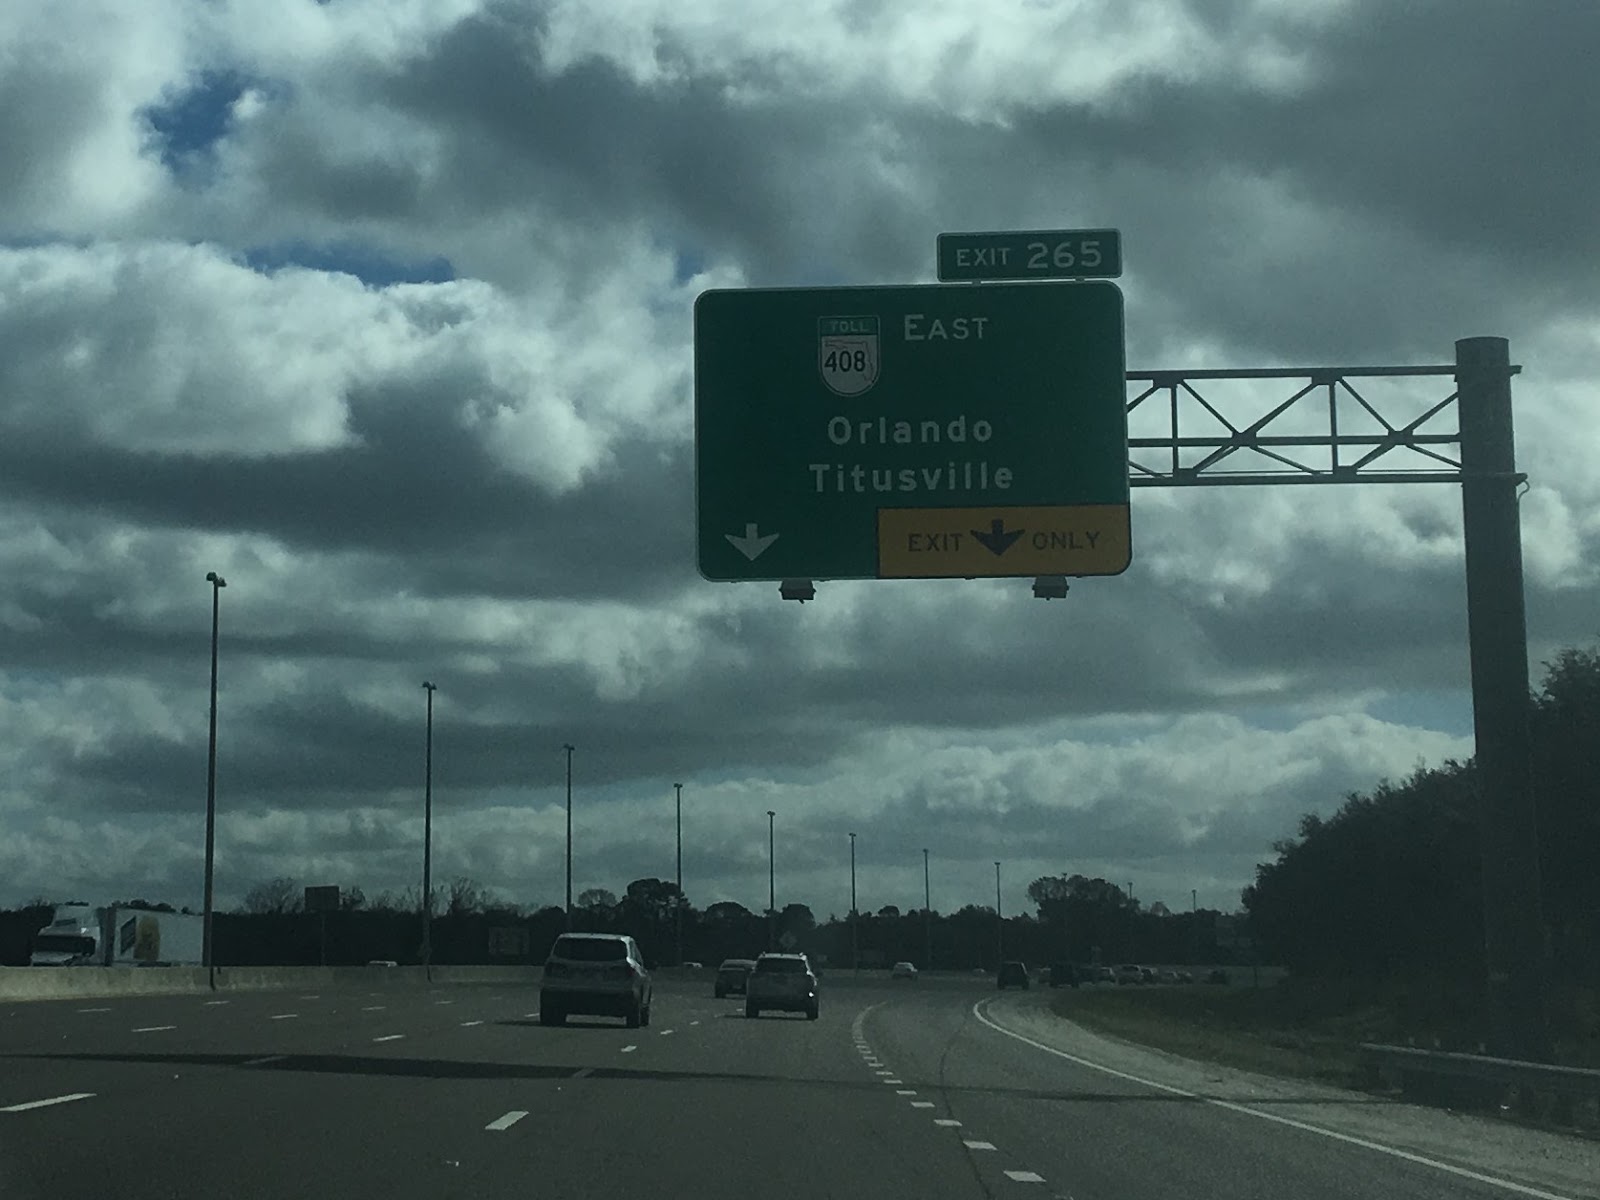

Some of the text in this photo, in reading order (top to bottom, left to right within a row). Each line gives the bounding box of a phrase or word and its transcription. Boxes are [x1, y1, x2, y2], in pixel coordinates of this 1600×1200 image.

[956, 240, 1102, 269] EXIT 265
[829, 319, 869, 333] TOLL
[904, 313, 989, 341] EAST
[823, 350, 866, 373] 408
[827, 415, 993, 445] Orlando
[809, 461, 1014, 492] Titusville
[908, 531, 1100, 553] EXIT ONLY
